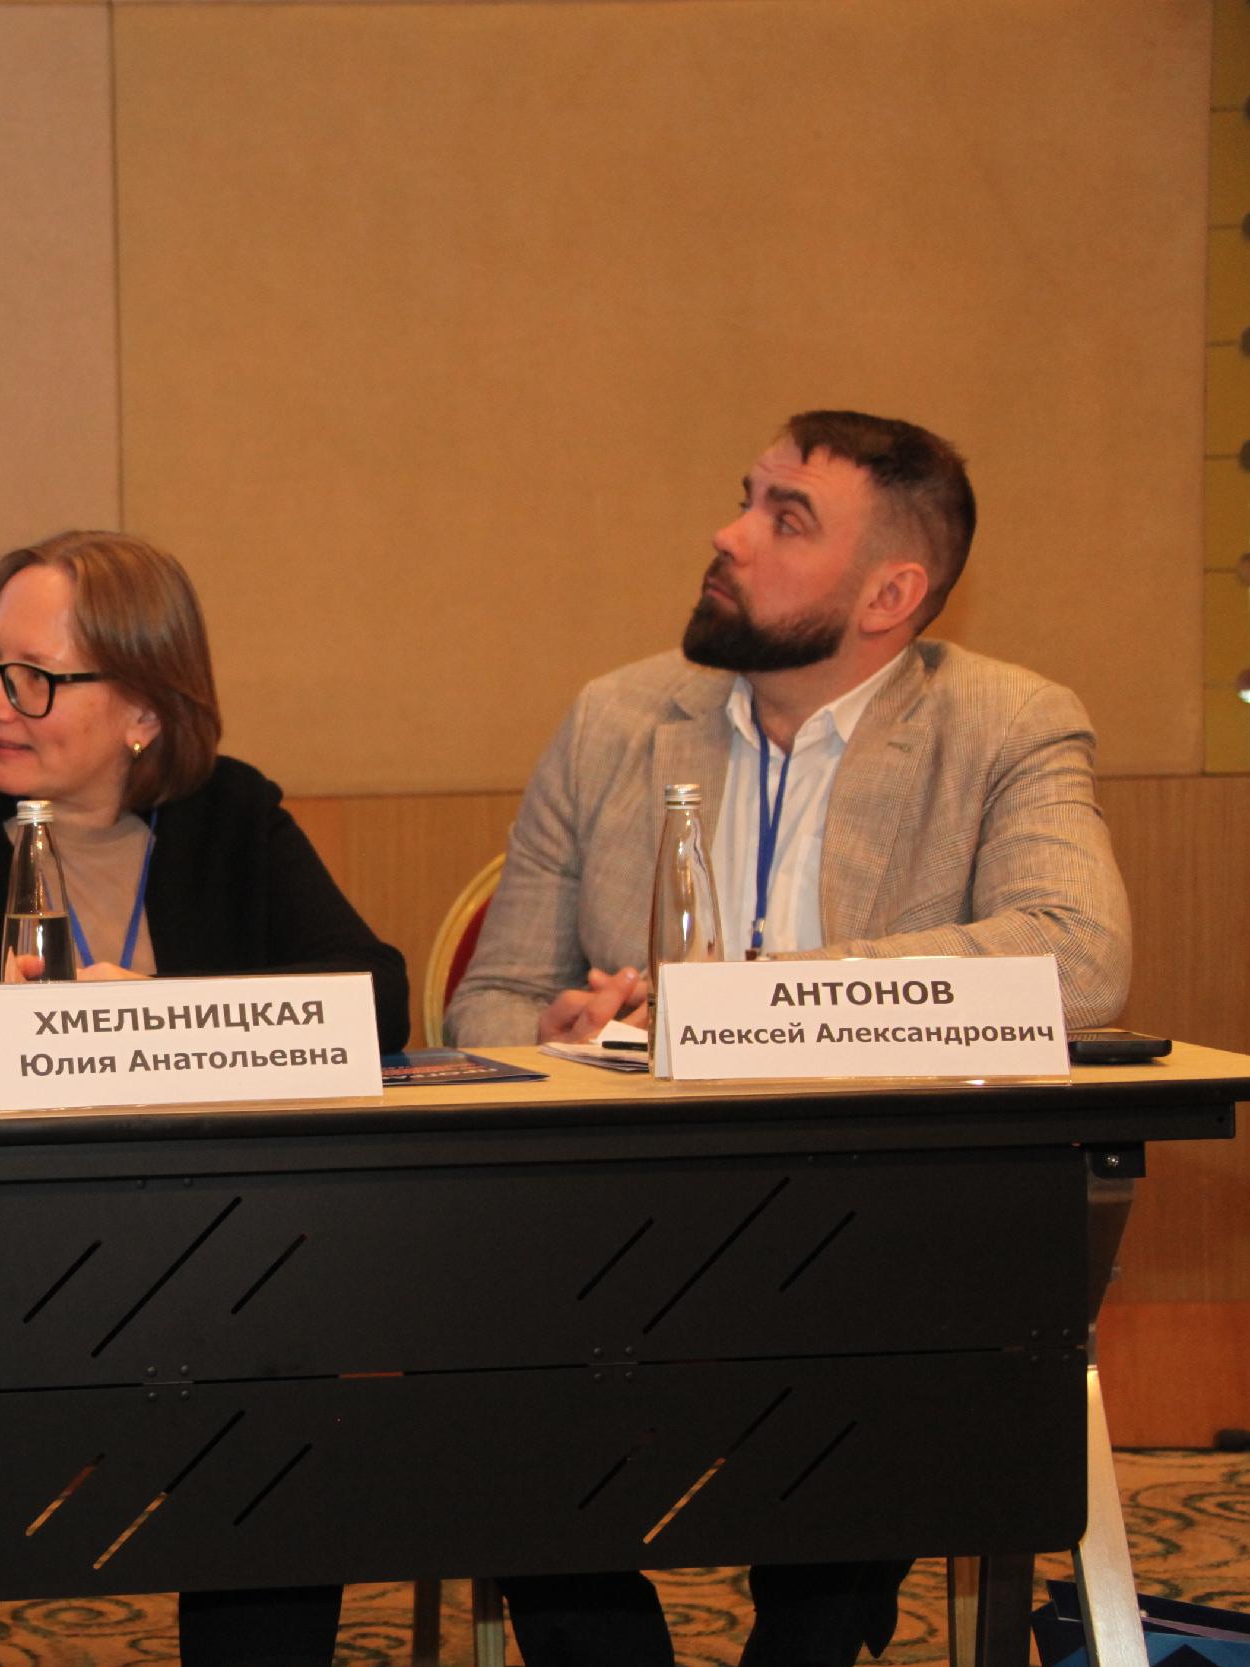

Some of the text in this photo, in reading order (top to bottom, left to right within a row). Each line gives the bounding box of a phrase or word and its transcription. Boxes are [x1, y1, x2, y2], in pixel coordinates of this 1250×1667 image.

[770, 980, 955, 1007] АНТОНОВ
[33, 1000, 324, 1036] ХМЕЛЬНИЦКАЯ
[679, 1021, 1054, 1047] Алексей Александрович
[20, 1047, 348, 1077] Юлия Анатольевна
